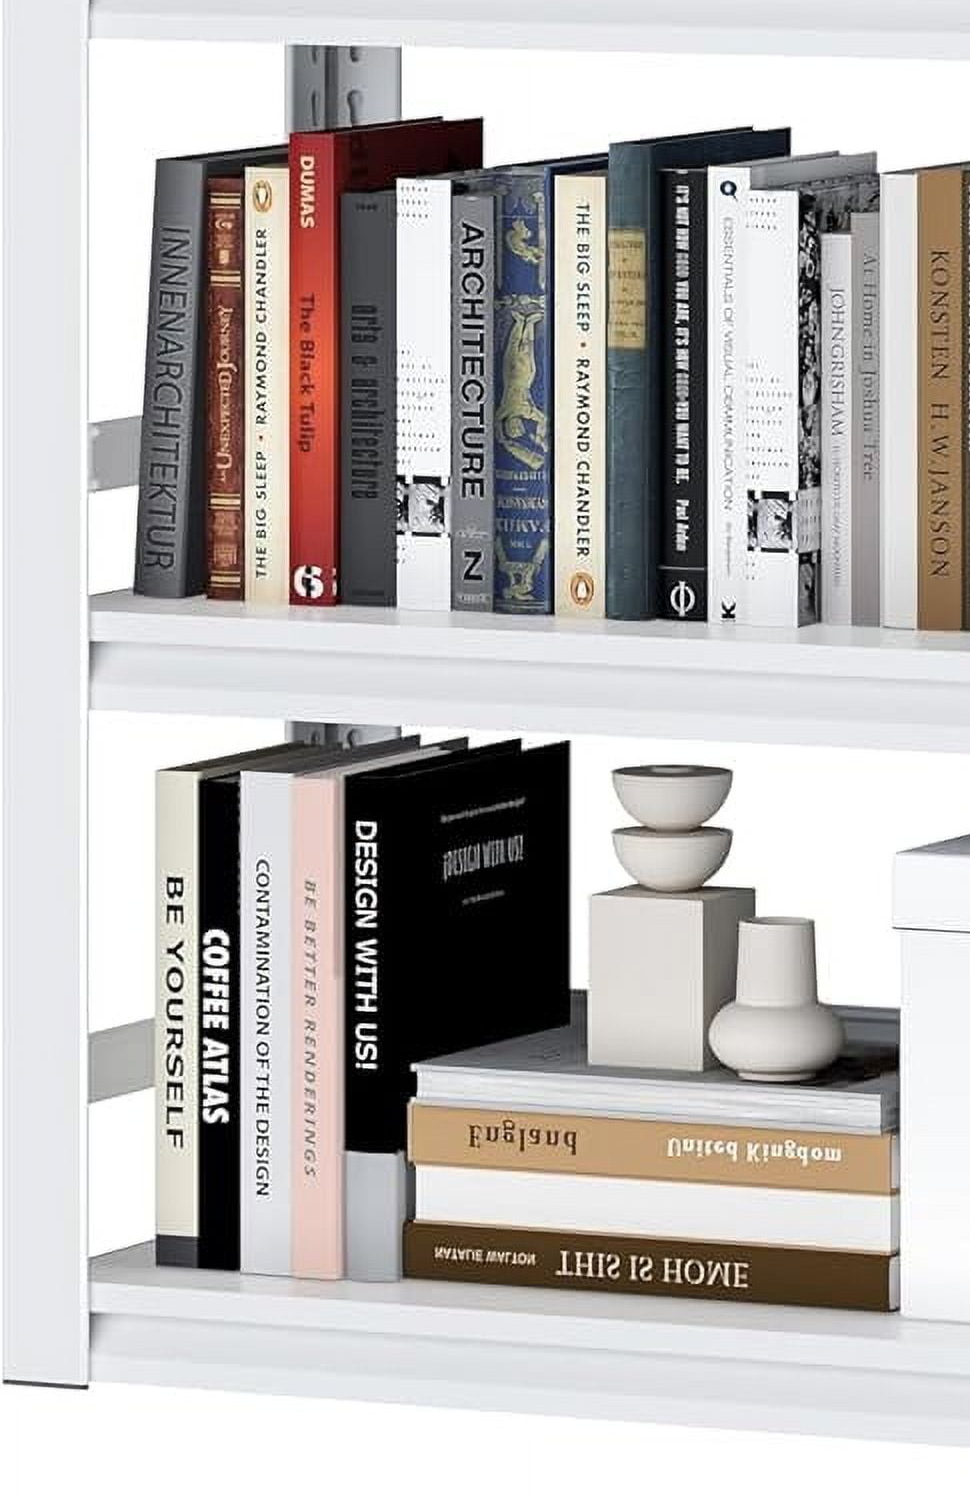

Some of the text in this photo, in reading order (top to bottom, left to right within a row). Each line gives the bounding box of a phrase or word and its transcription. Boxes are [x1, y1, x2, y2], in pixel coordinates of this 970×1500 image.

[299, 155, 316, 230] DUMAS
[350, 303, 379, 344] arts
[722, 216, 736, 304] ESSENTIALS
[722, 307, 736, 324] OF
[861, 282, 879, 338] Home
[929, 250, 950, 380] KONSTEN
[143, 227, 192, 571] INNENARCHITEKTUR
[216, 305, 238, 372] JOURNEY
[296, 294, 316, 453] The Black Tulip
[461, 222, 486, 499] ARCHITECTURE
[575, 202, 592, 558] THE BIG SLEEP RAYMOND CHANDLER
[722, 330, 736, 381] VISUAL
[861, 370, 879, 432] Joshua
[215, 372, 232, 469] UNEXPECTED
[254, 227, 268, 579] THE BIG SLEEP RAYMOND CHANDLER
[350, 379, 379, 500] architecture
[722, 384, 736, 512] COMMUNICATION
[861, 440, 879, 481] Tree
[354, 819, 378, 1071] DESIGN WITH US!
[165, 875, 185, 1149] BE YOURSELF
[202, 928, 230, 1124] COFFEE ATLAS
[255, 858, 270, 1198] CONTAMINATION OF THE DESIGN
[303, 879, 317, 1179] BE BETTER RENDERINGS
